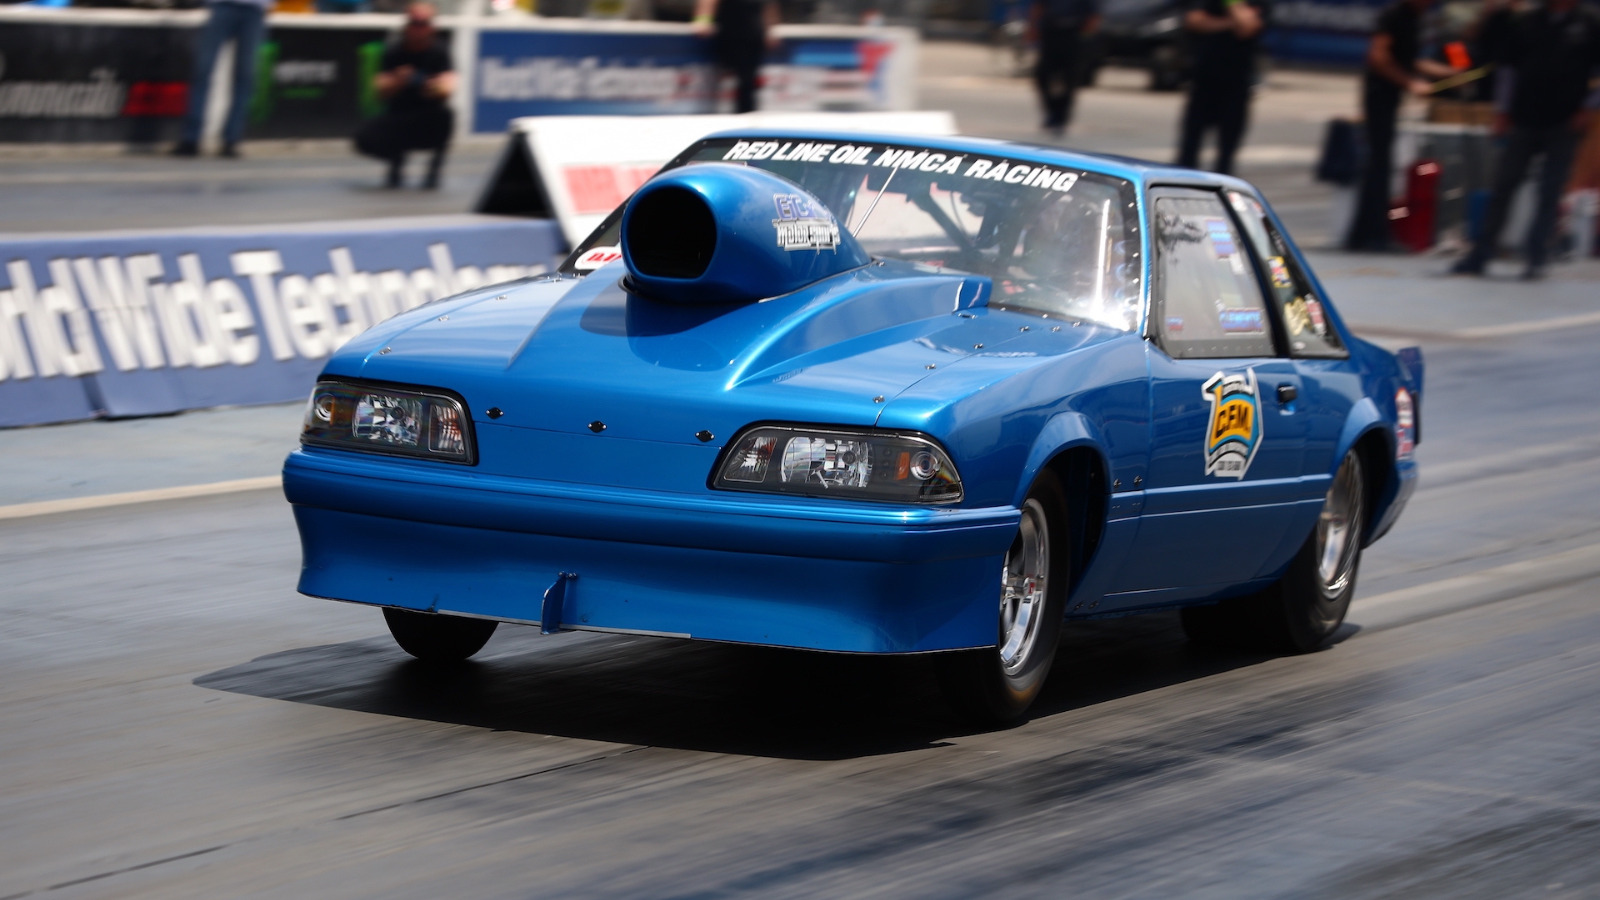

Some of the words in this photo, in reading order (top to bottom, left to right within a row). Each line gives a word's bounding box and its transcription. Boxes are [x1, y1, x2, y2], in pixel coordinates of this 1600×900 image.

[722, 141, 780, 160] RED
[771, 142, 836, 163] LINE
[828, 145, 873, 165] OIL
[873, 149, 963, 174] NMCA
[963, 158, 1079, 192] RACING
[0, 257, 104, 382] rld
